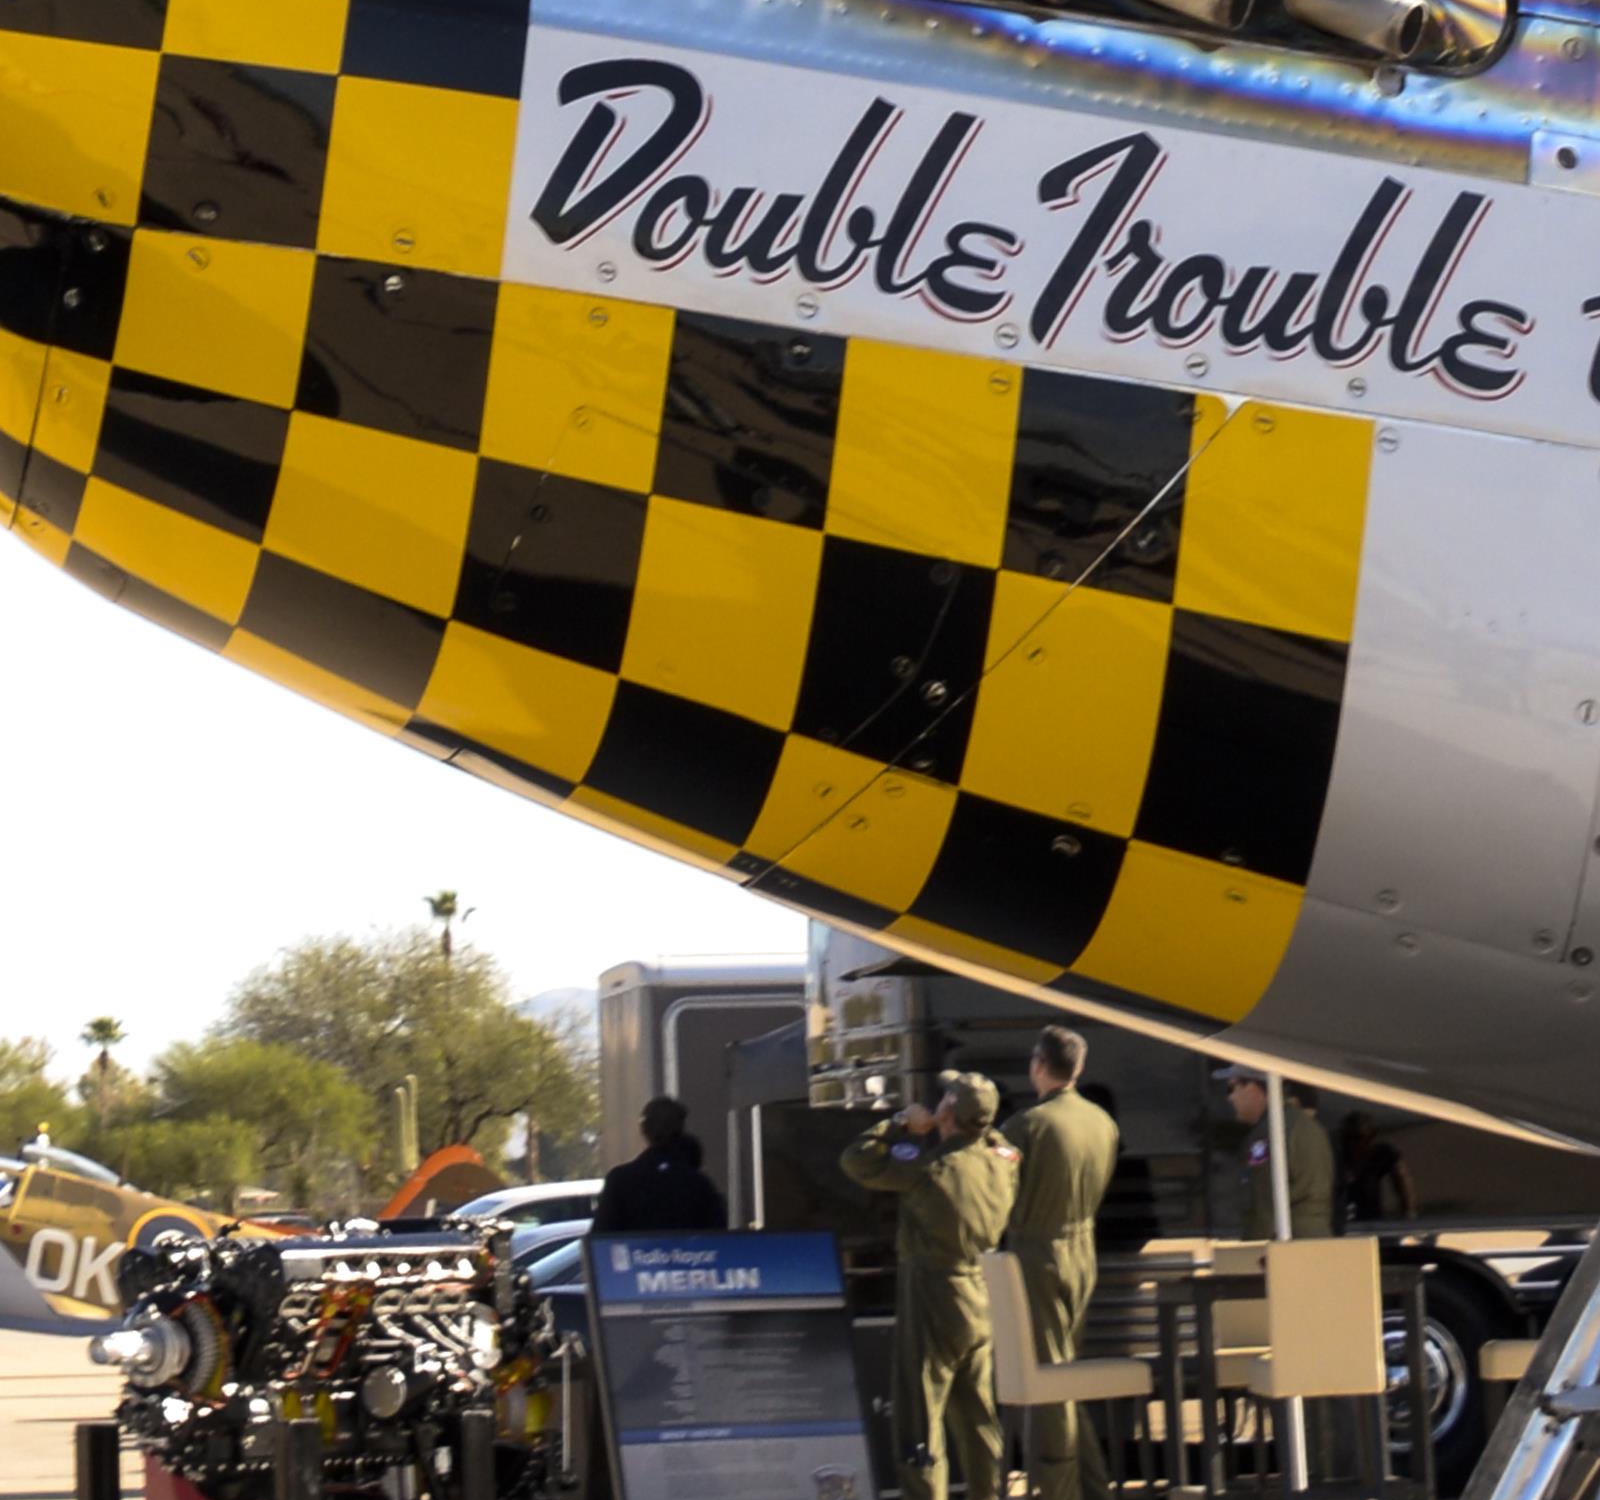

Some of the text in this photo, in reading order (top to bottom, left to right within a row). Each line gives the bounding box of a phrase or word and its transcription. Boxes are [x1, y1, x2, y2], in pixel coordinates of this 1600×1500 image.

[529, 58, 1024, 323] Double
[1029, 131, 1535, 402] Trouble
[24, 1226, 127, 1306] OK
[636, 1267, 761, 1294] MERLIN
